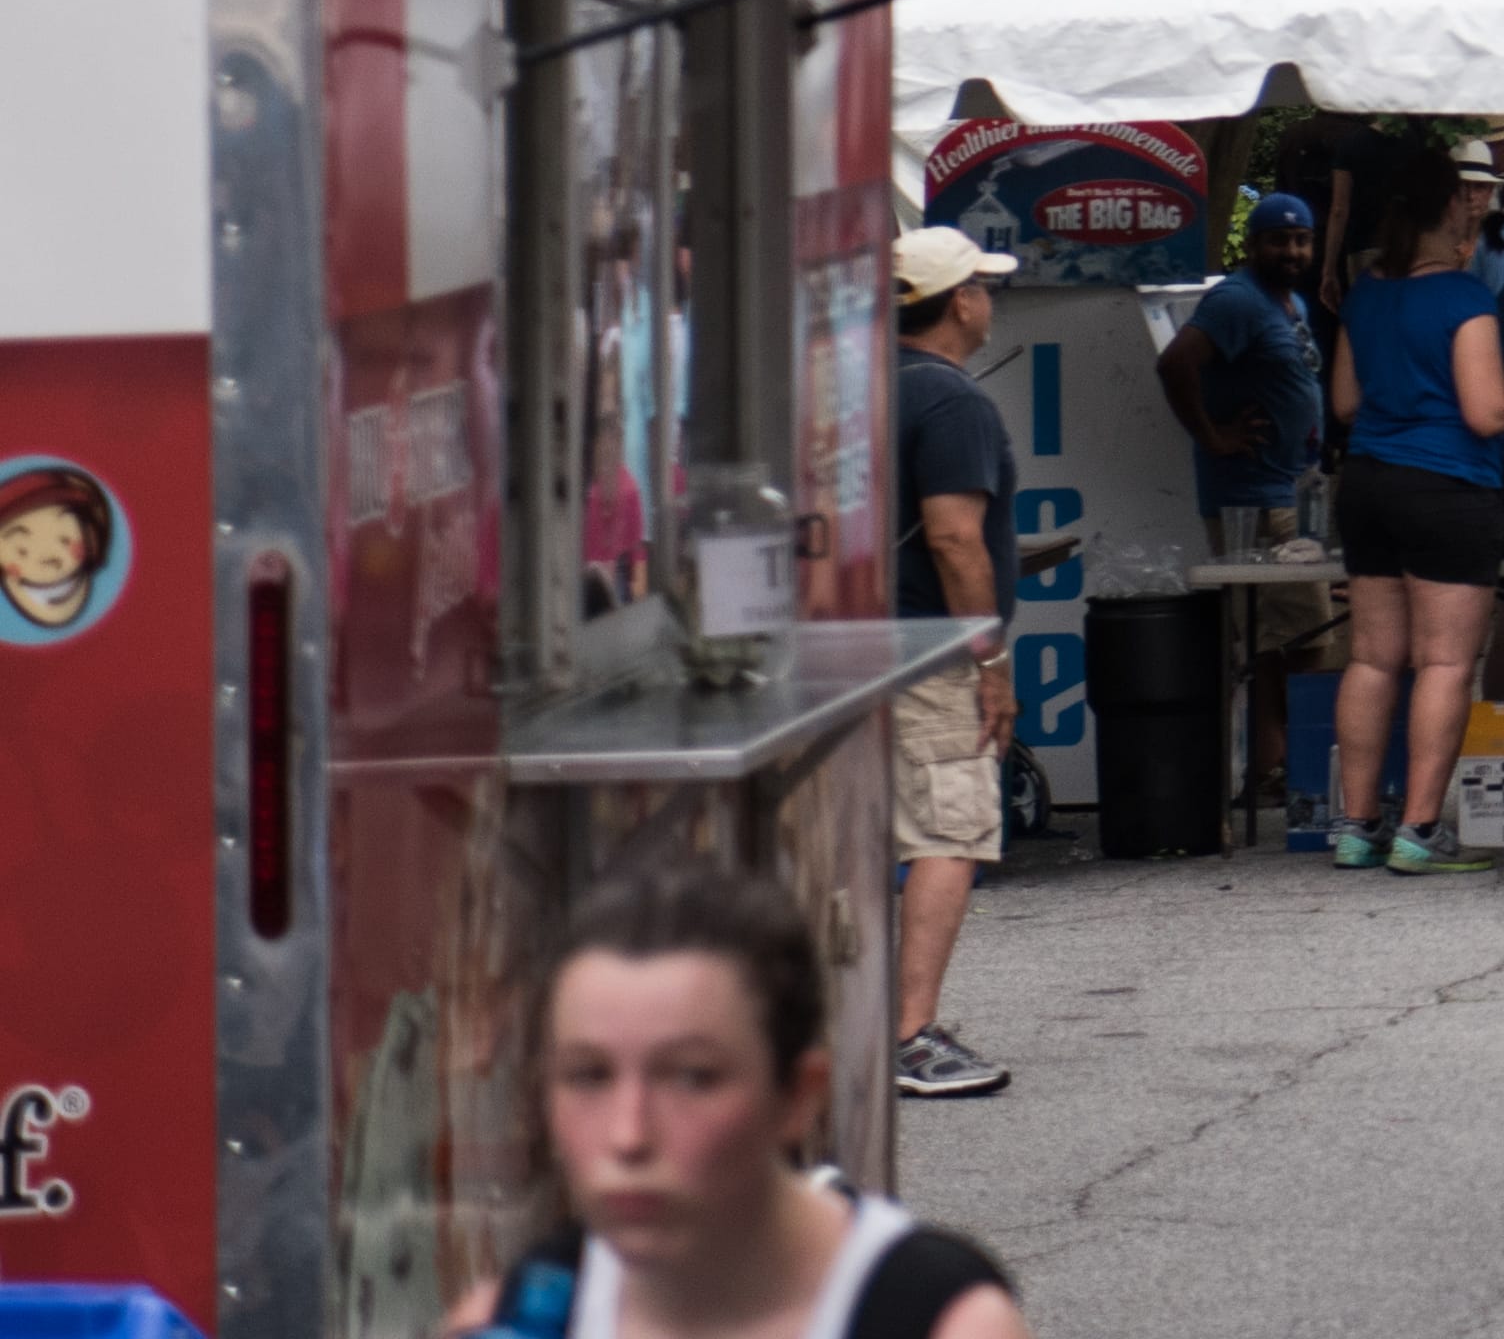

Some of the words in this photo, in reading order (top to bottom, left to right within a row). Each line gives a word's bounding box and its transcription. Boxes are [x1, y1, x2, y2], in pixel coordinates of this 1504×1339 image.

[928, 120, 1019, 183] Healthier
[1045, 202, 1083, 230] THE
[1088, 197, 1133, 230] BIG
[1137, 200, 1182, 230] BAG
[1014, 343, 1086, 747] Ice
